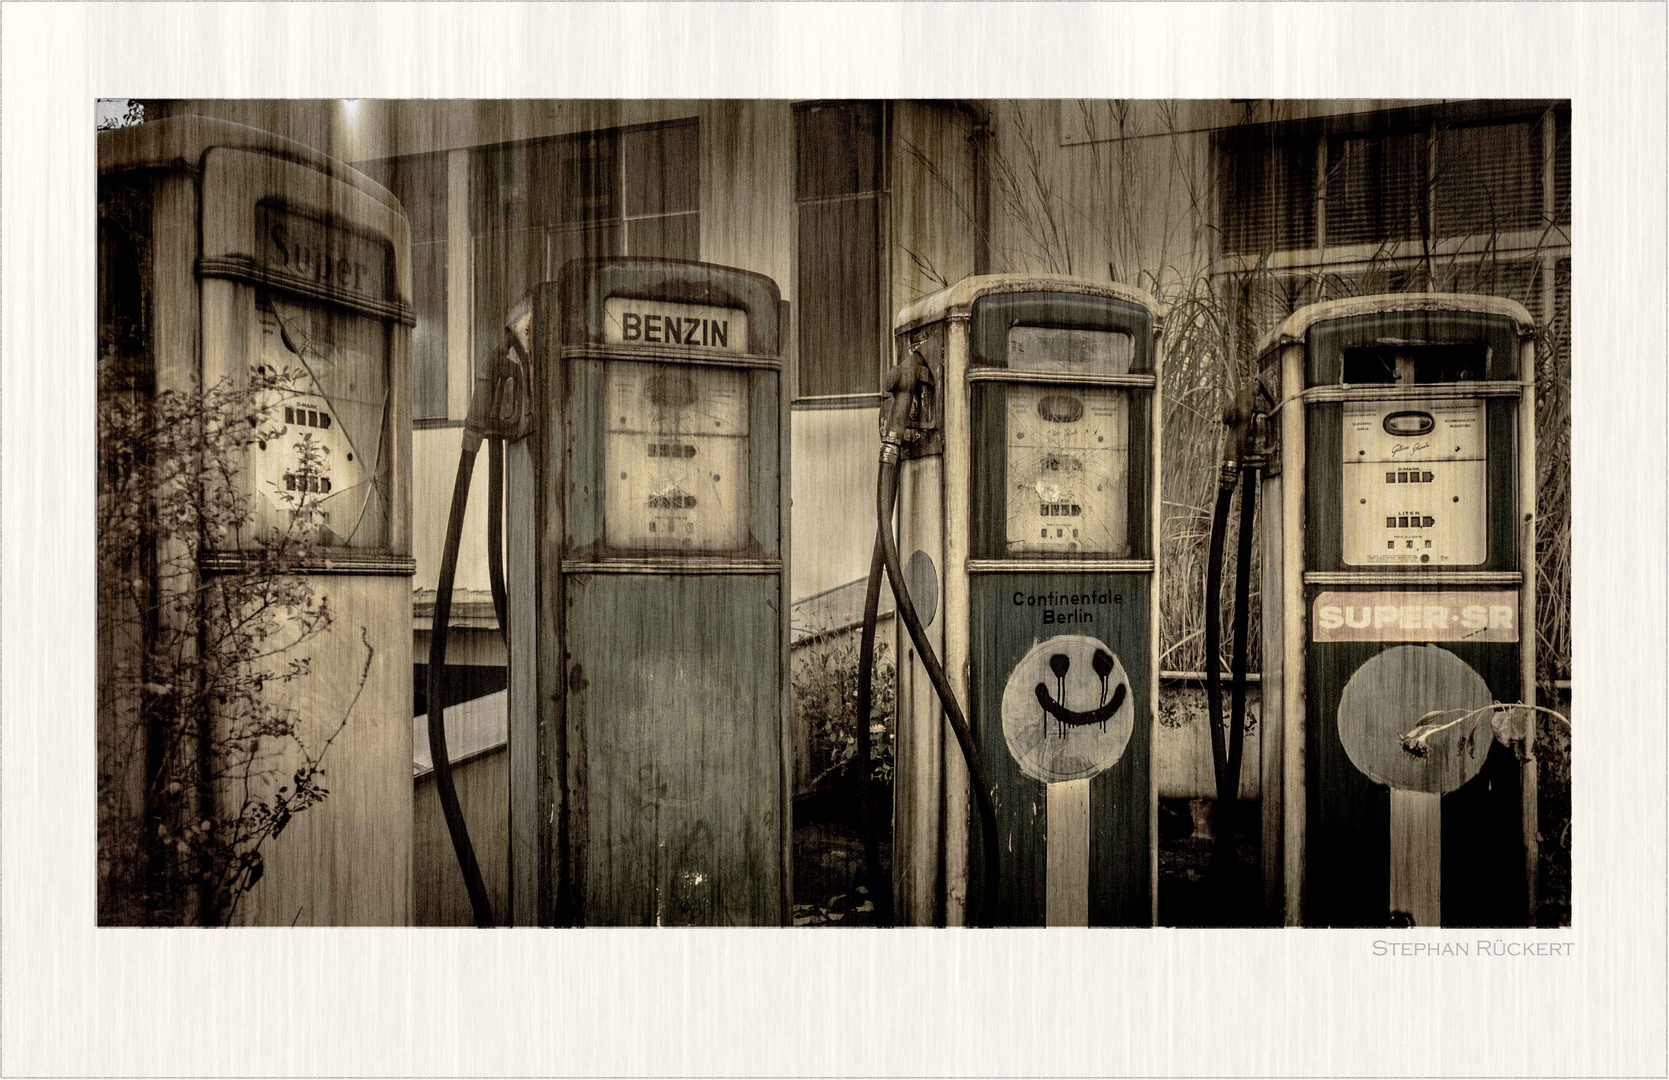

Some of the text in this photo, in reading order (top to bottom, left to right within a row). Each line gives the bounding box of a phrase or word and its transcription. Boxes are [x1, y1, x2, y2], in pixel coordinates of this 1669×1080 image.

[622, 312, 728, 348] BENZIN
[296, 402, 318, 410] D-MARK
[1012, 589, 1123, 607] Continentale
[1042, 608, 1094, 625] Berlin
